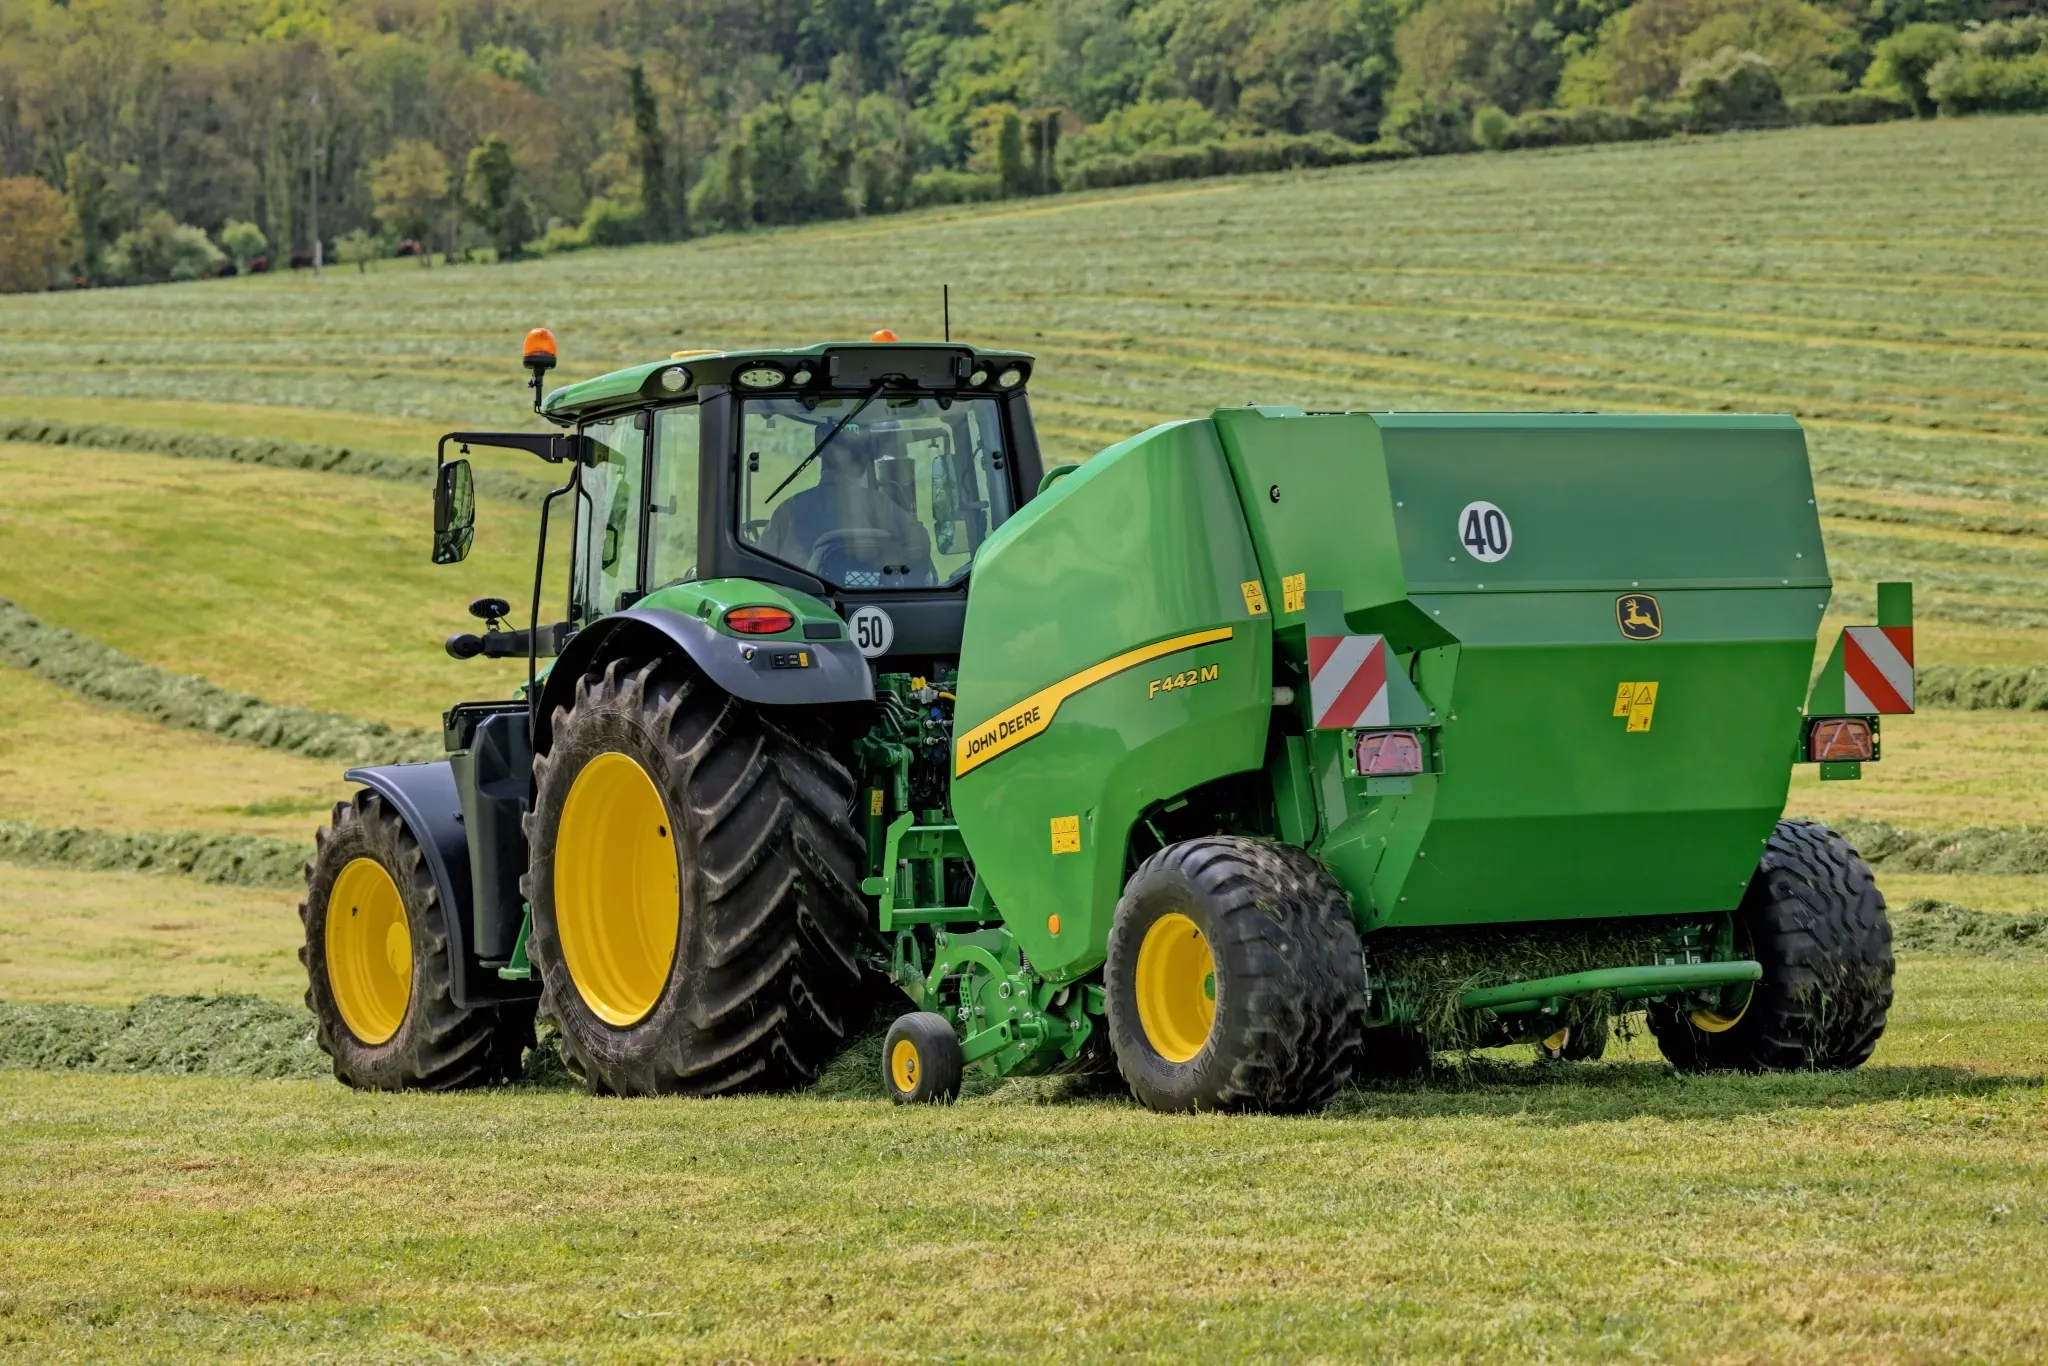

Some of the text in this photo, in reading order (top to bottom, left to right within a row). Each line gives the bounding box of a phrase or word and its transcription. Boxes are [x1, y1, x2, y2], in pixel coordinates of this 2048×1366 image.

[1464, 509, 1507, 555] 40
[857, 615, 883, 649] 50
[966, 706, 1041, 759] JOHN DEERE
